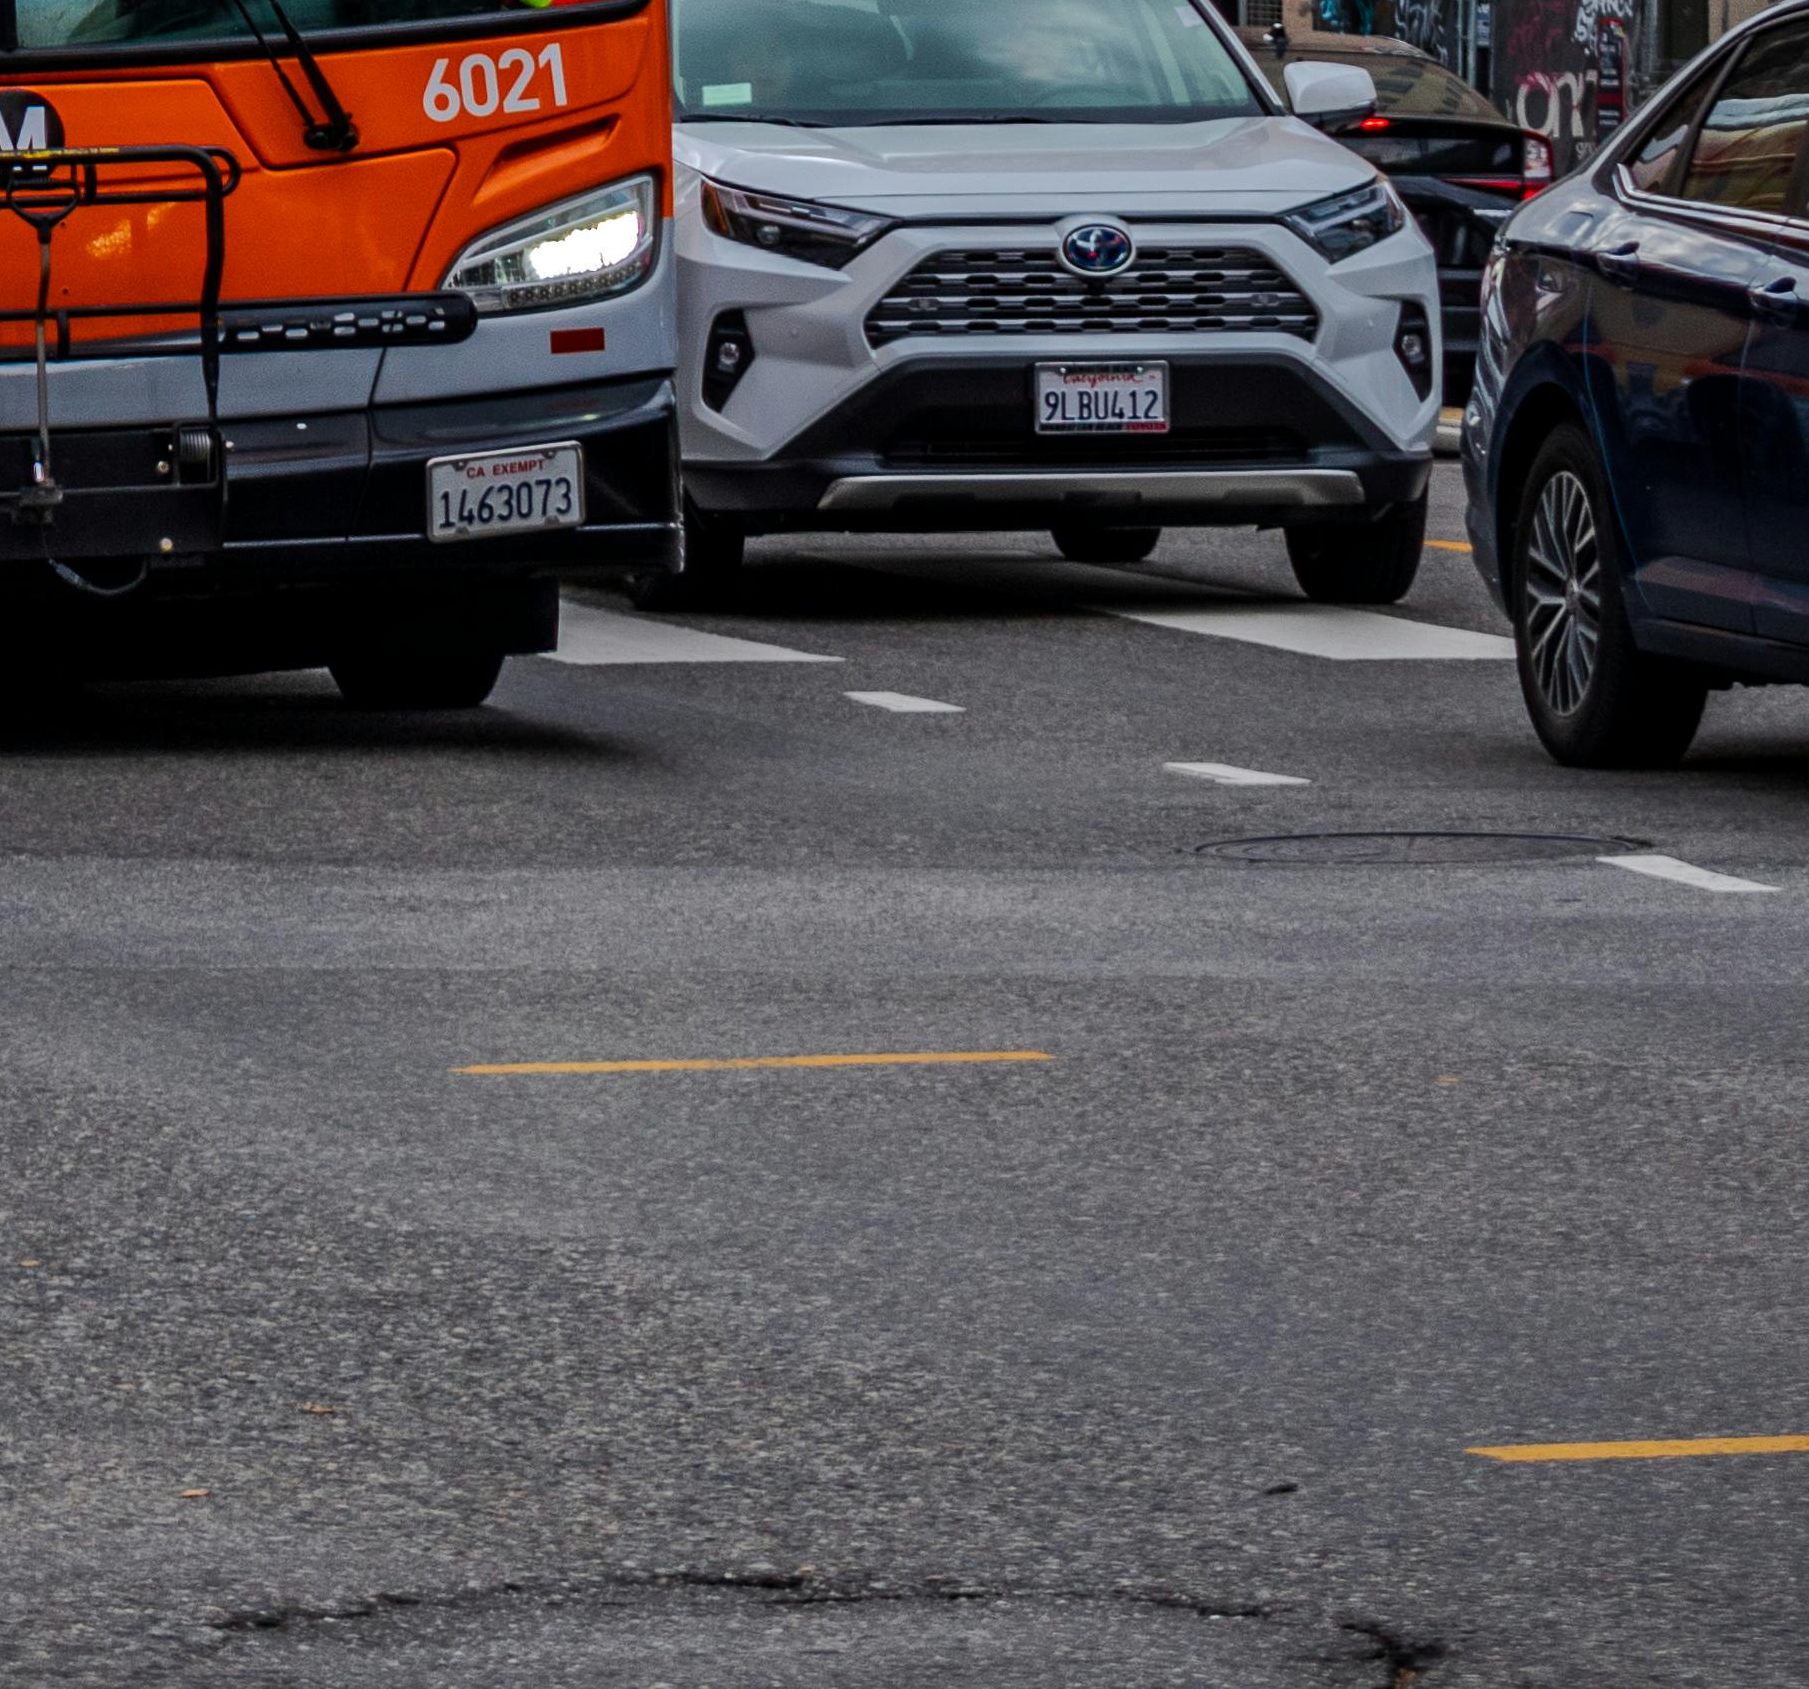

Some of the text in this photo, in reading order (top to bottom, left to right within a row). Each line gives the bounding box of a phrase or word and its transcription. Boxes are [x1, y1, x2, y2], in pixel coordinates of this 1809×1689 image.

[423, 43, 568, 122] 6021
[1044, 389, 1159, 421] 9LBU412
[466, 458, 544, 479] CA EXEMPT
[439, 477, 572, 528] 1463073
